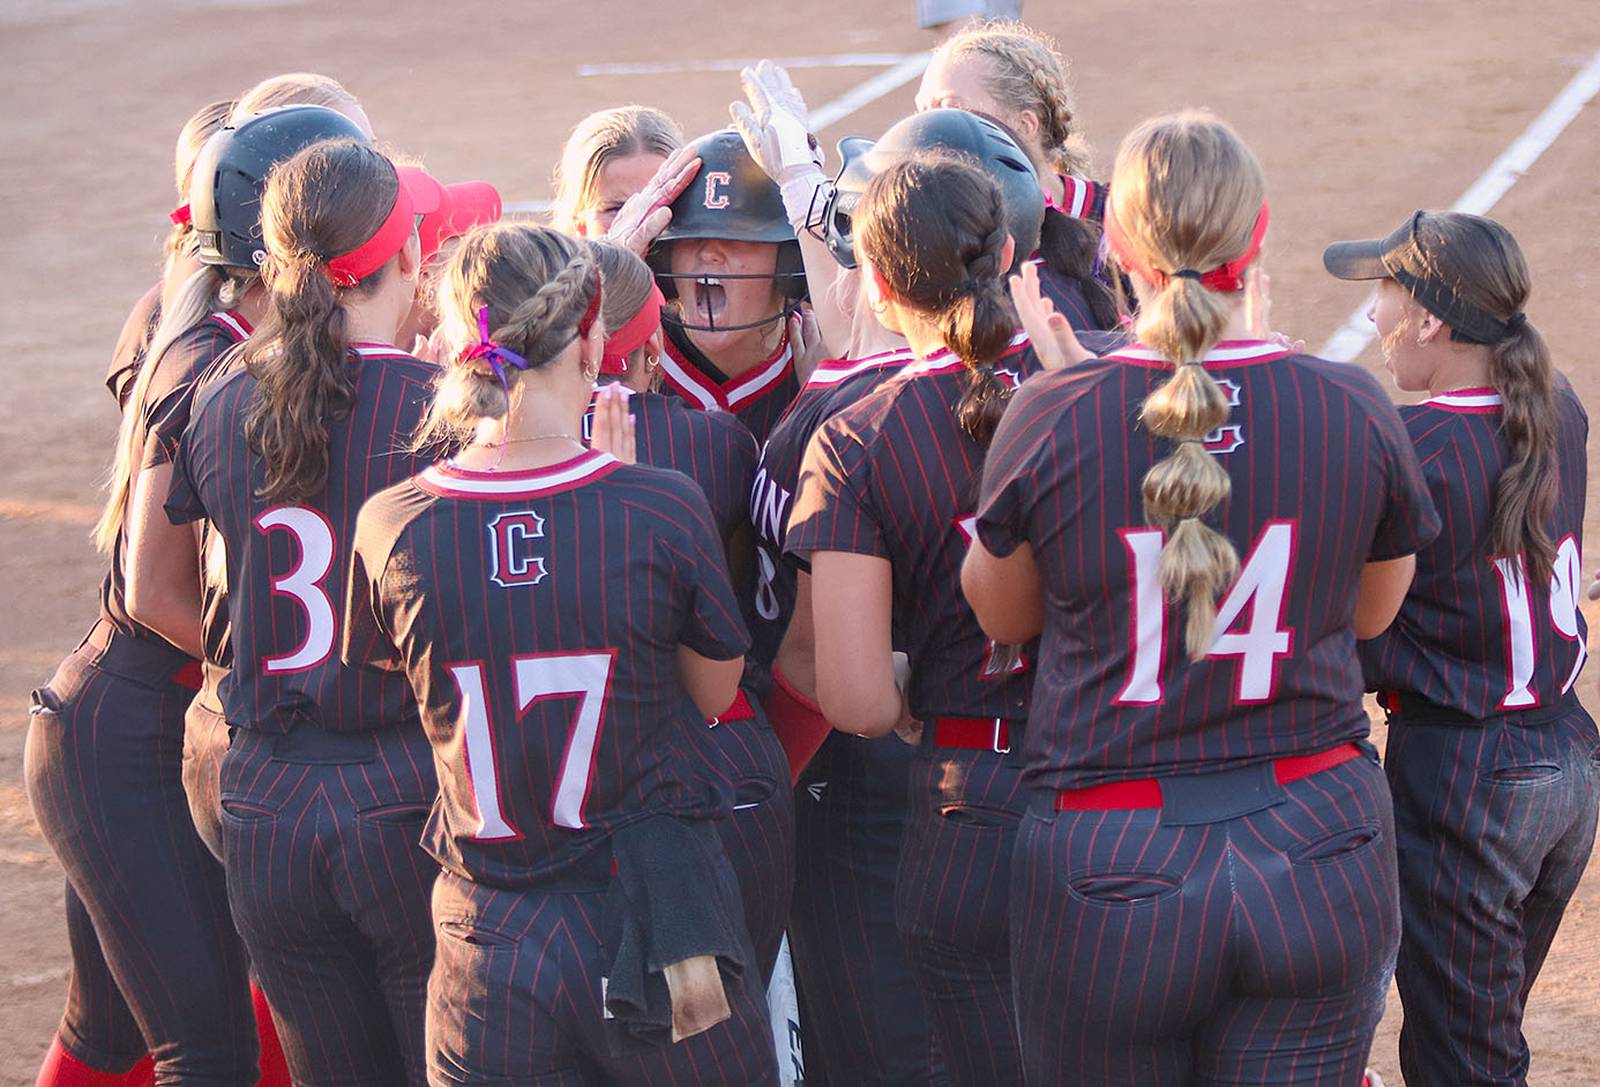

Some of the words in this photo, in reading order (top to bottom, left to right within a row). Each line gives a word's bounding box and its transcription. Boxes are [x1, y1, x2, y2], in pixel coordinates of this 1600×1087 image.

[703, 172, 731, 209] C
[488, 510, 549, 588] C
[751, 440, 790, 548] ON
[253, 503, 338, 675] 3
[1110, 518, 1297, 706] 14
[442, 648, 617, 842] 17
